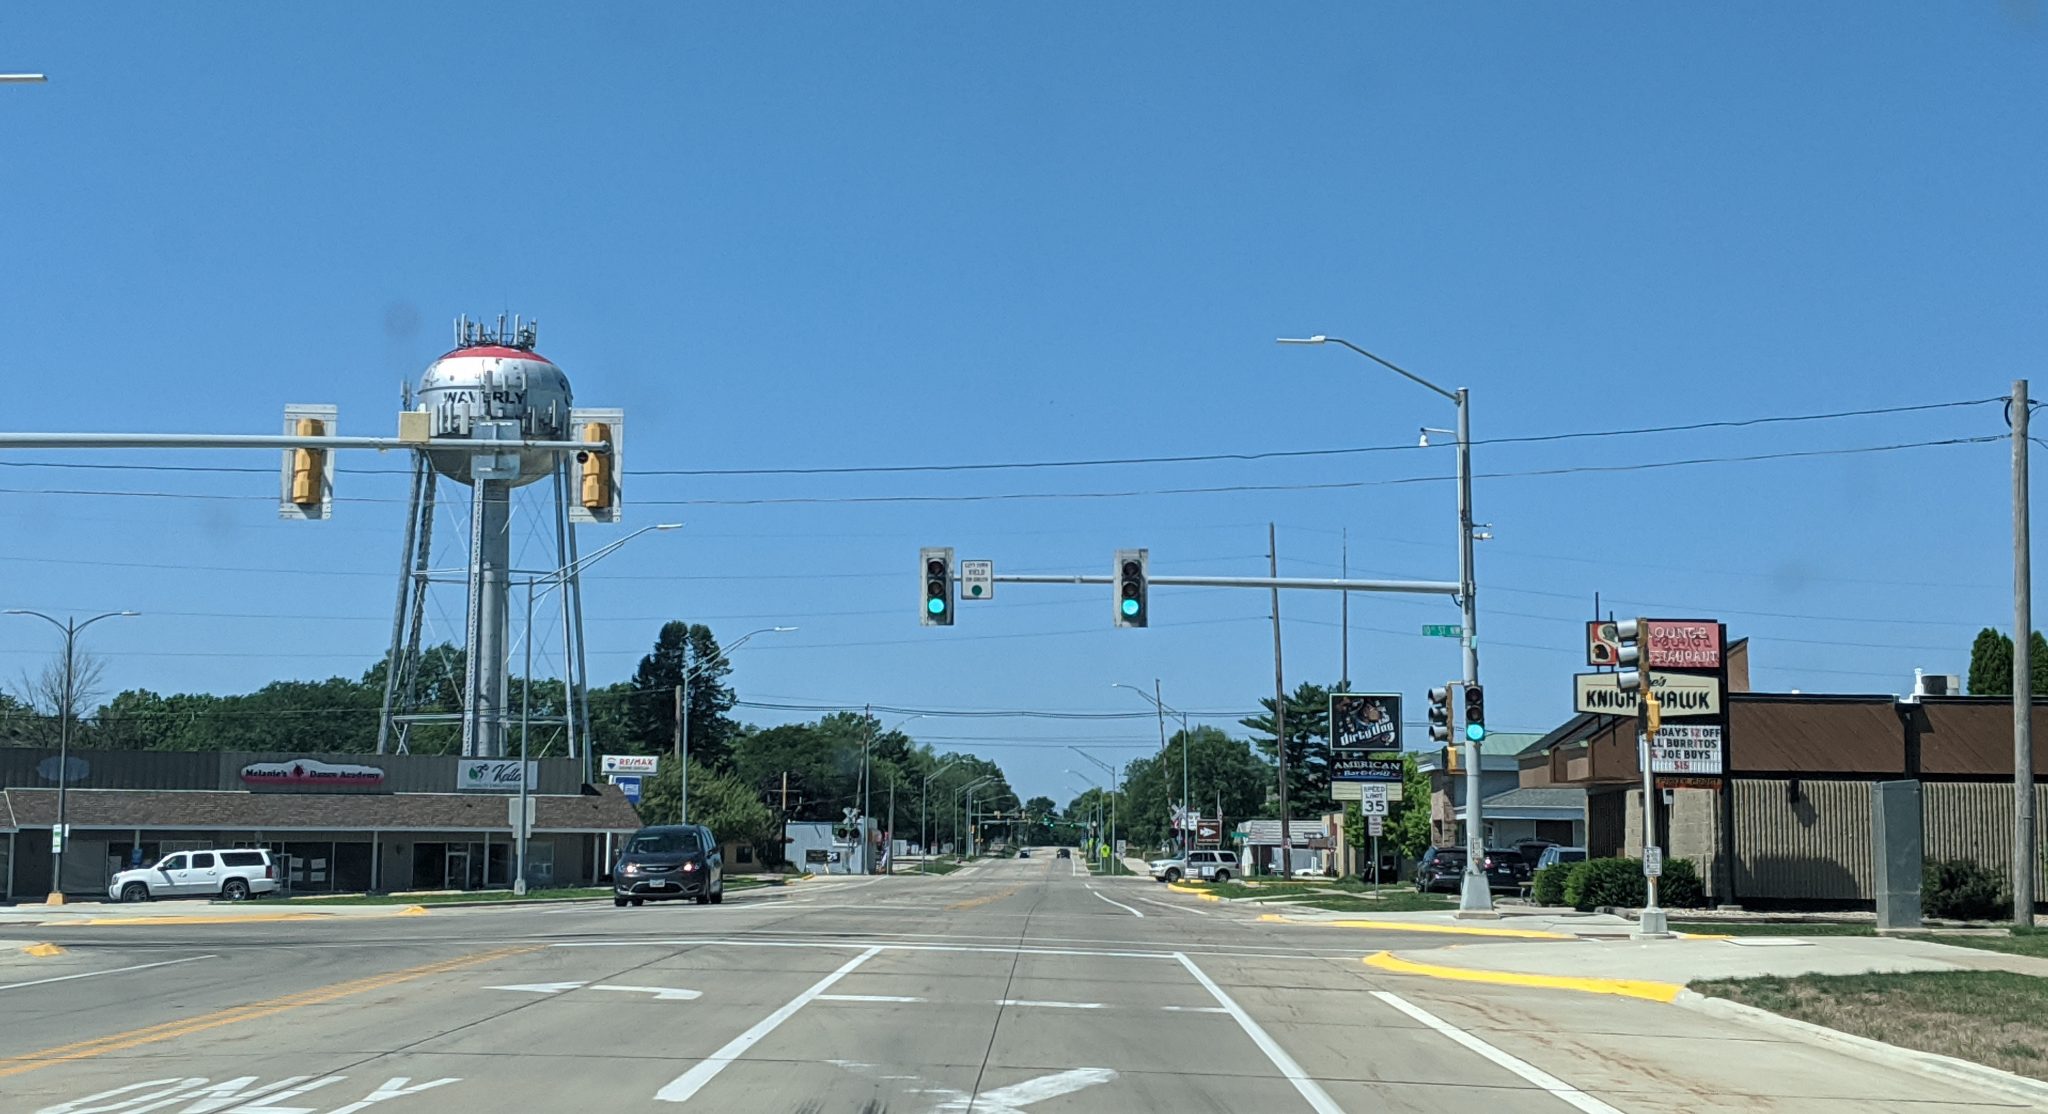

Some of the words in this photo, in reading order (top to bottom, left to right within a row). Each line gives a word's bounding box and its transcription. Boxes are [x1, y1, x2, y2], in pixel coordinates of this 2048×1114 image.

[1586, 689, 1710, 710] KNIGHHAWK
[1702, 728, 1721, 738] OFF
[1651, 738, 1665, 748] LL
[1666, 738, 1717, 748] BURRITOS
[1661, 749, 1682, 758] JOE
[1684, 750, 1711, 760] BUYS
[618, 758, 654, 767] RE/MAX
[1334, 760, 1400, 770] AMERICAN
[245, 768, 288, 778] Melanie's
[340, 770, 381, 780] Academy
[1363, 785, 1386, 793] SPEED
[1364, 800, 1385, 812] 35
